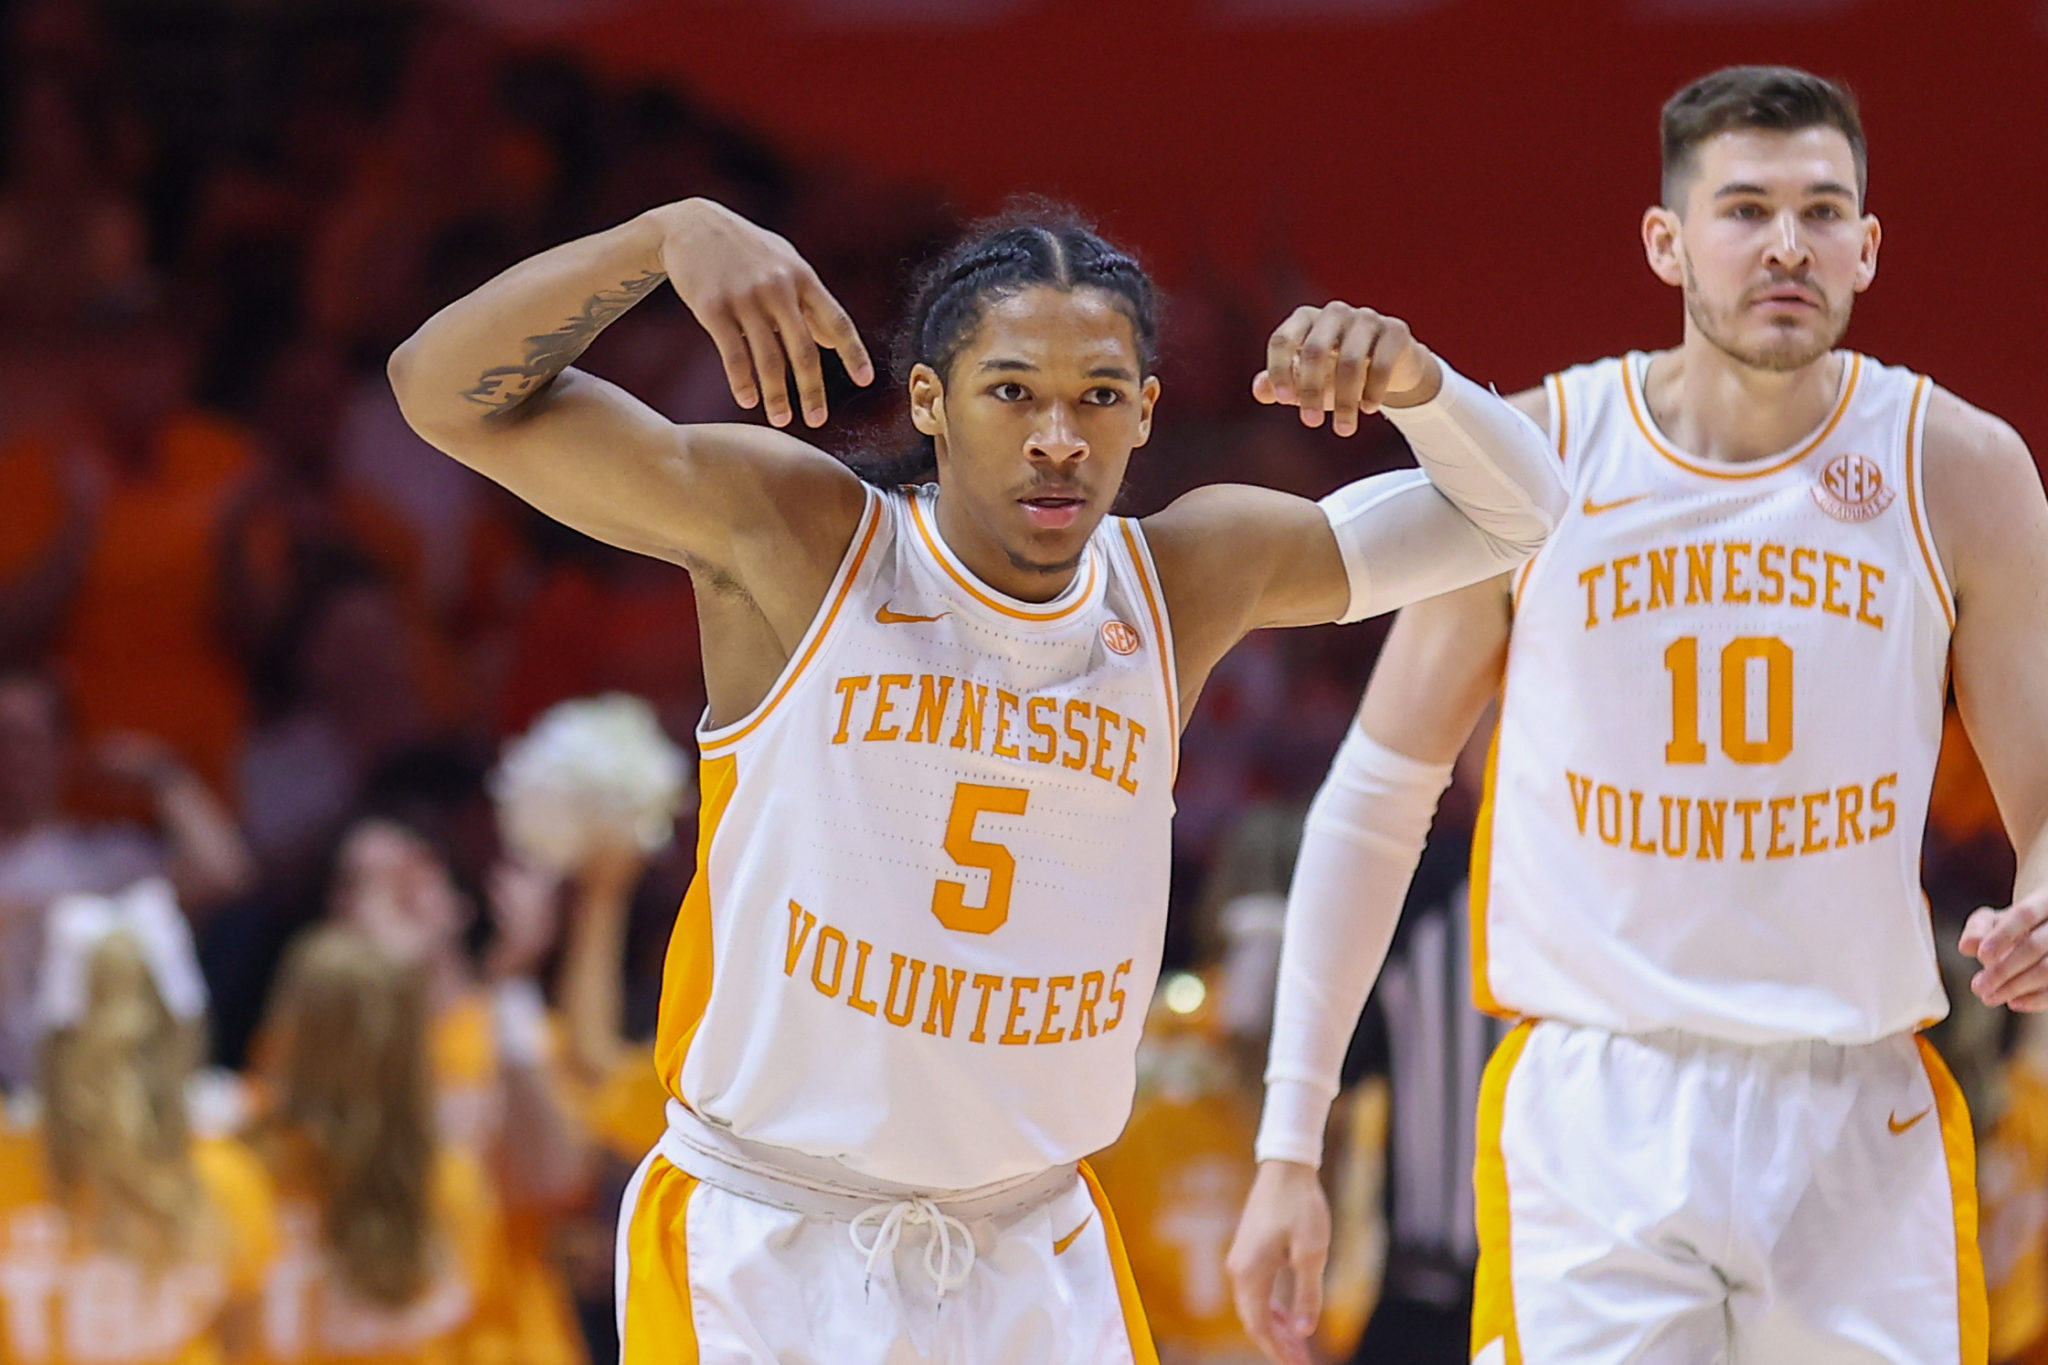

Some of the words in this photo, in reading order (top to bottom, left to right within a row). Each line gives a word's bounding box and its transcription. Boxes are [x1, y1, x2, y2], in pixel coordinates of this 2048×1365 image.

[1826, 455, 1879, 501] SEC
[1103, 622, 1138, 652] SEC
[1578, 542, 1885, 630] TENNESSEE
[832, 674, 1147, 795] TENNESSEE
[1664, 636, 1794, 765] 10
[931, 782, 1030, 935] 5
[1566, 770, 1898, 862] VOLUNTEERS
[784, 898, 1134, 1046] VOLUNTEERS
